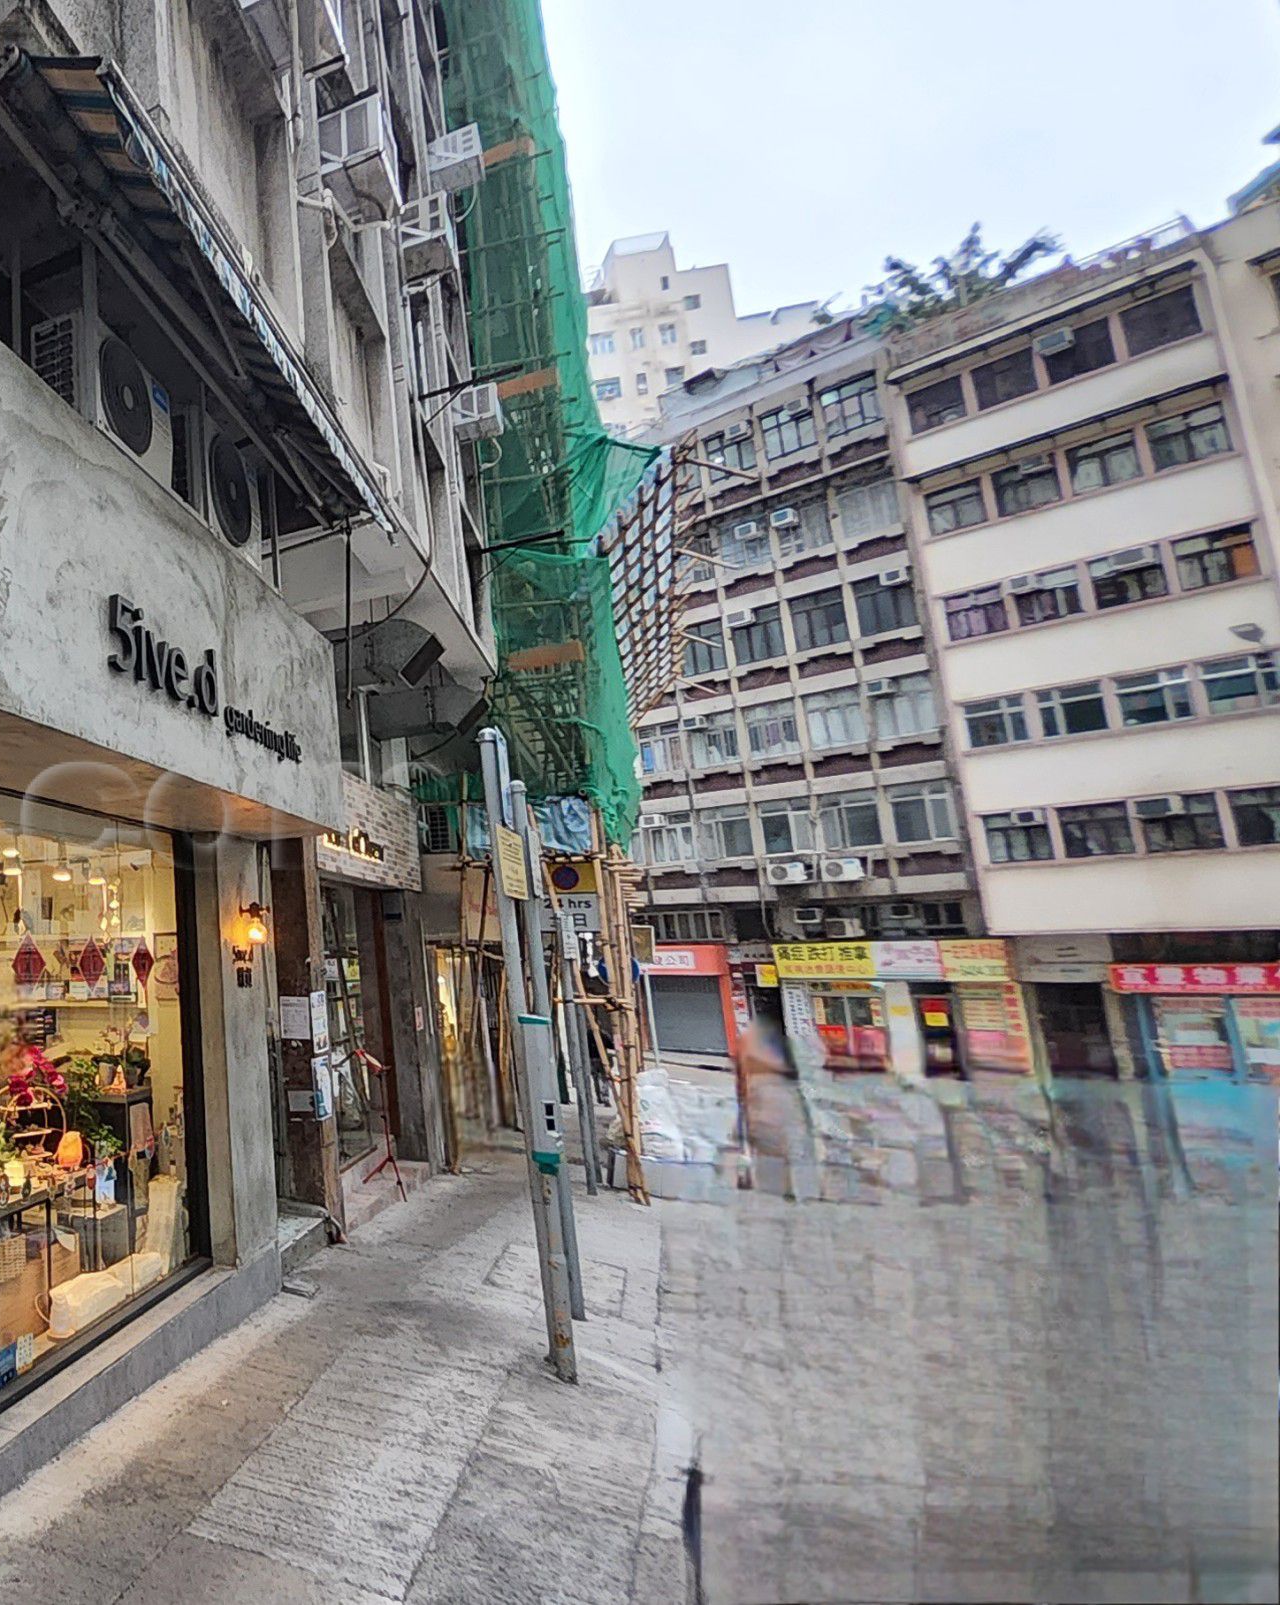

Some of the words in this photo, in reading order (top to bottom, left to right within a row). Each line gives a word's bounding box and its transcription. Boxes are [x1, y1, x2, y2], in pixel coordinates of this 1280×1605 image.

[107, 592, 220, 717] 5ive.d
[223, 704, 285, 762] gardening
[284, 730, 303, 763] life
[568, 898, 592, 909] hrs
